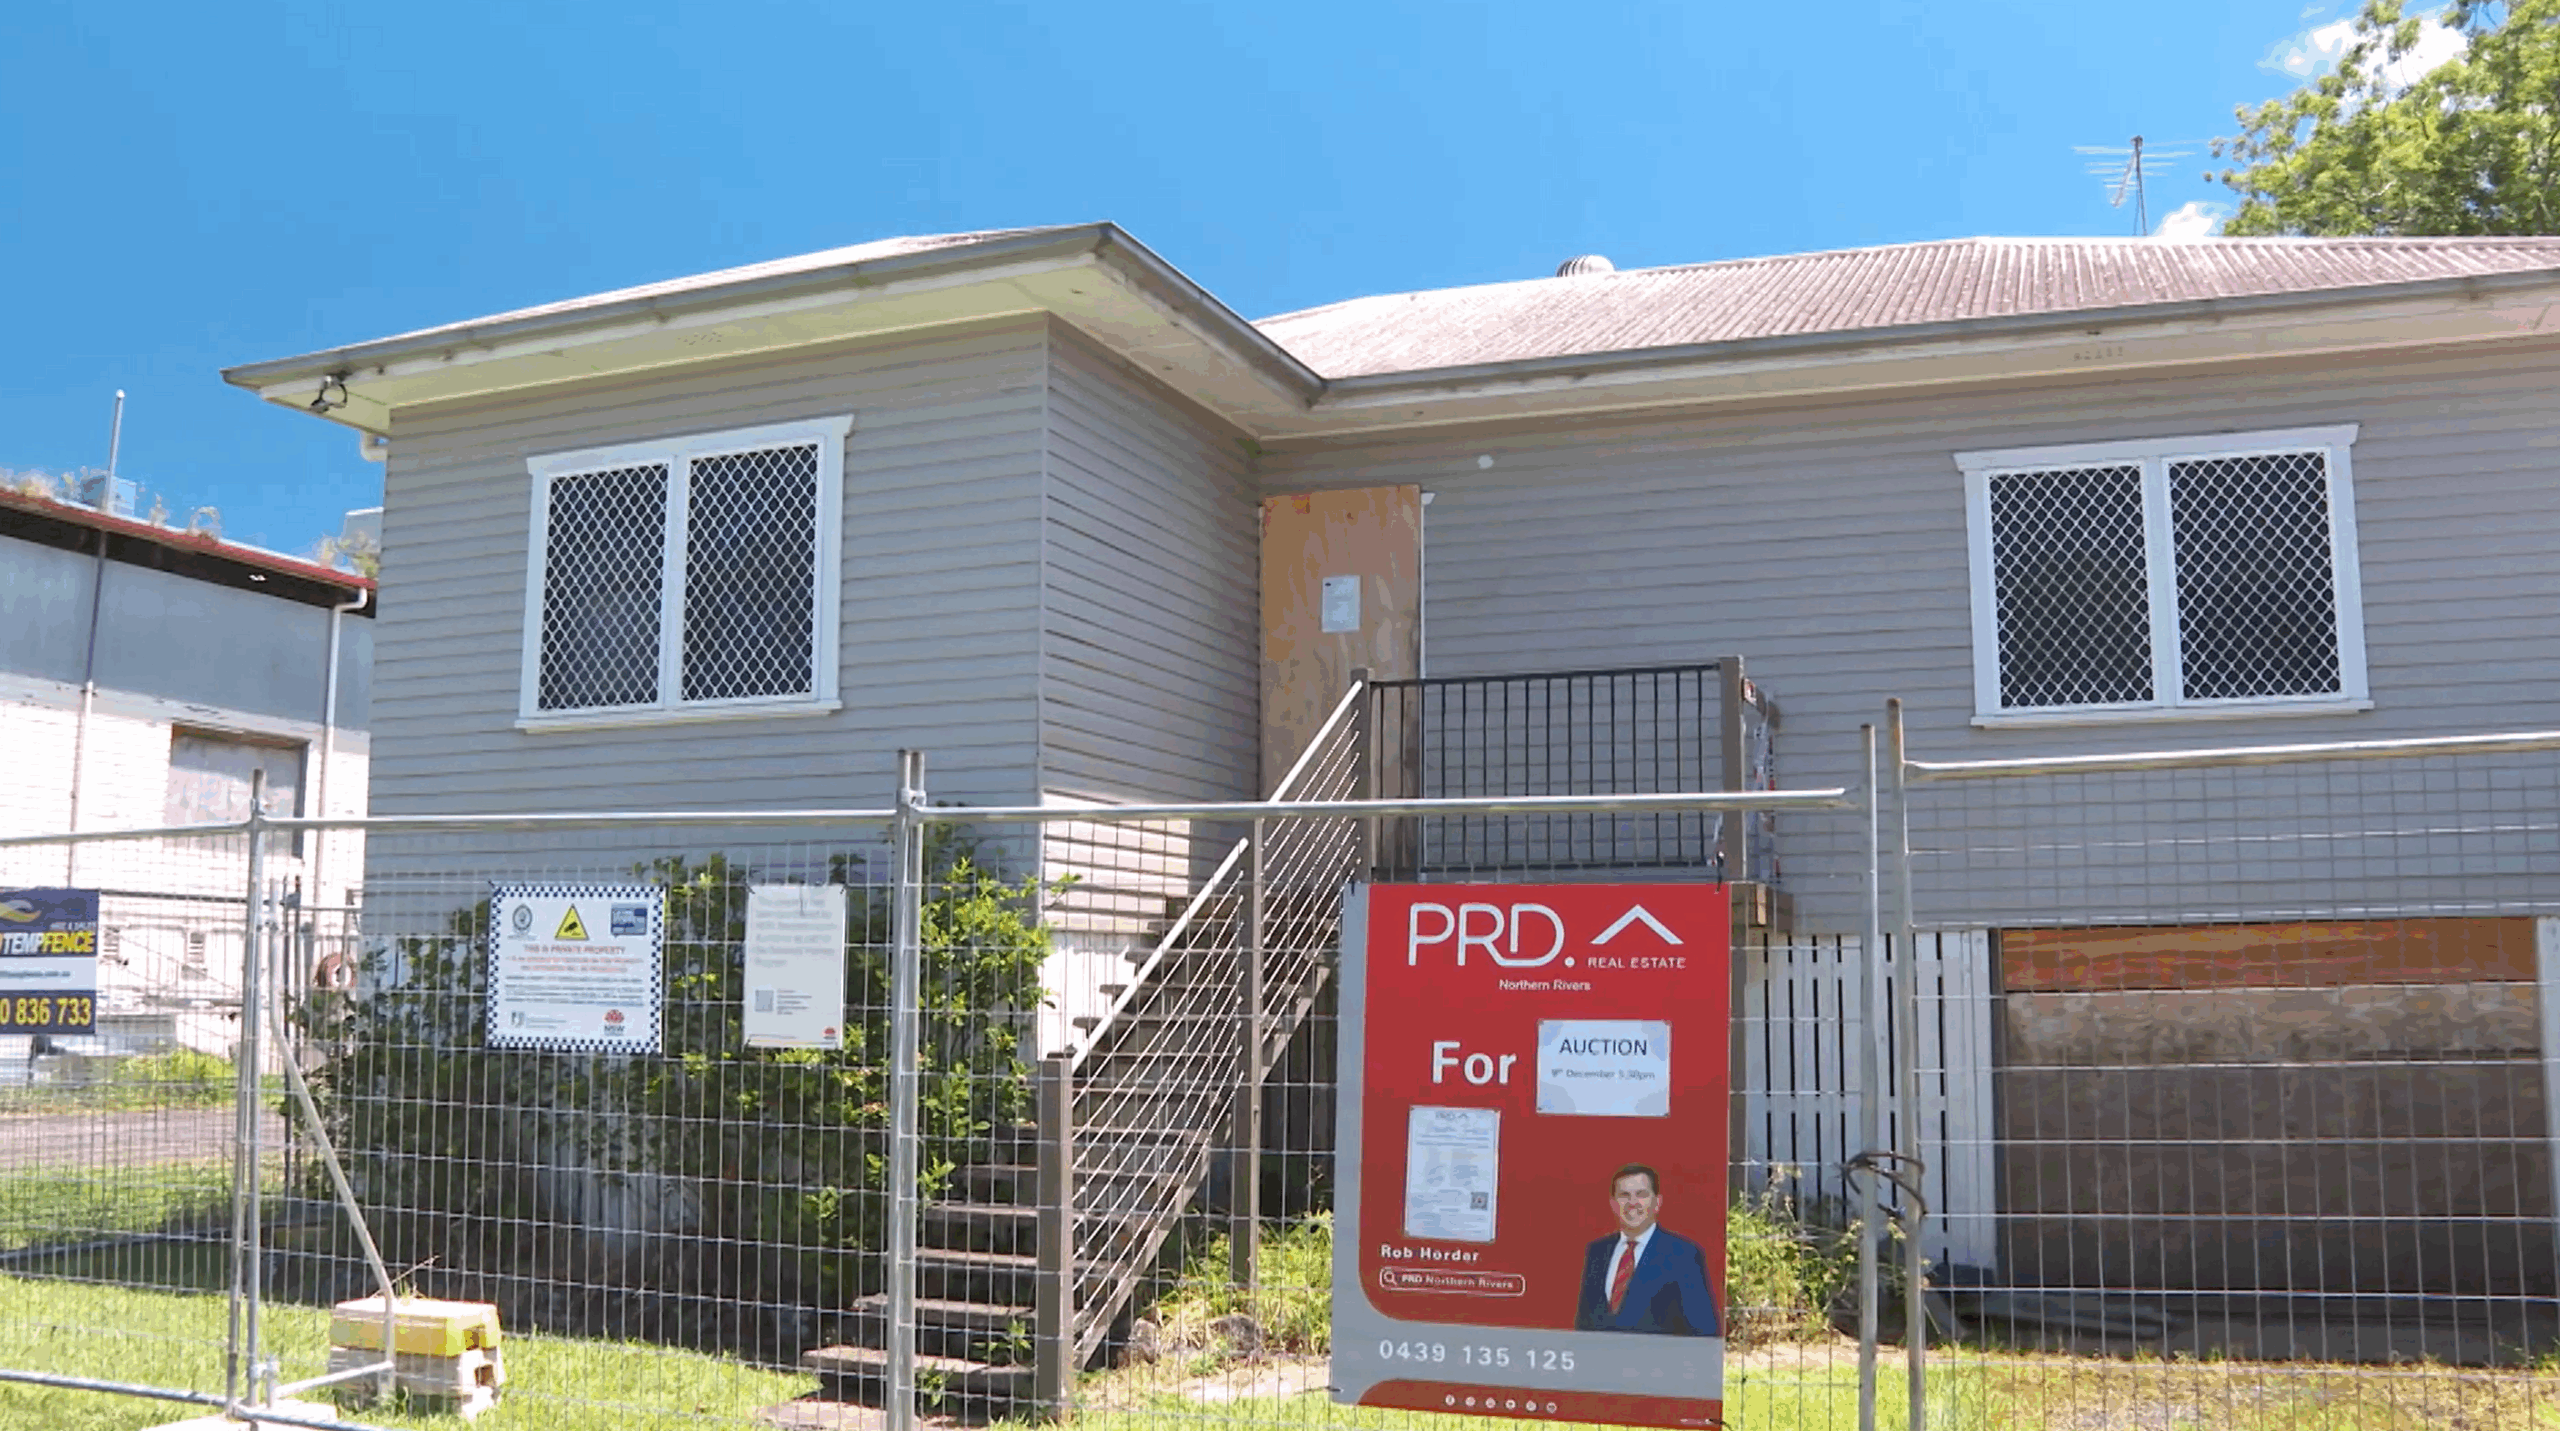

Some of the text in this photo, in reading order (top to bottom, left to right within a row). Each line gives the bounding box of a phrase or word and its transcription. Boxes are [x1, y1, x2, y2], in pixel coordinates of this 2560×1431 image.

[0, 931, 96, 955] TEMPFENCE
[551, 945, 582, 954] PRIVATE
[584, 945, 626, 955] PROPERTY
[1587, 956, 1687, 970] REAL ESTATE
[1499, 978, 1592, 992] Northern Rivers
[16, 997, 51, 1026] 836
[56, 998, 92, 1026] 733
[1559, 1038, 1647, 1056] AUCTION
[1431, 1040, 1518, 1084] For
[1381, 1244, 1479, 1262] Rob Horder
[1401, 1274, 1514, 1289] PRD Northern Rivers
[1379, 1340, 1575, 1371] 0439 135 125
